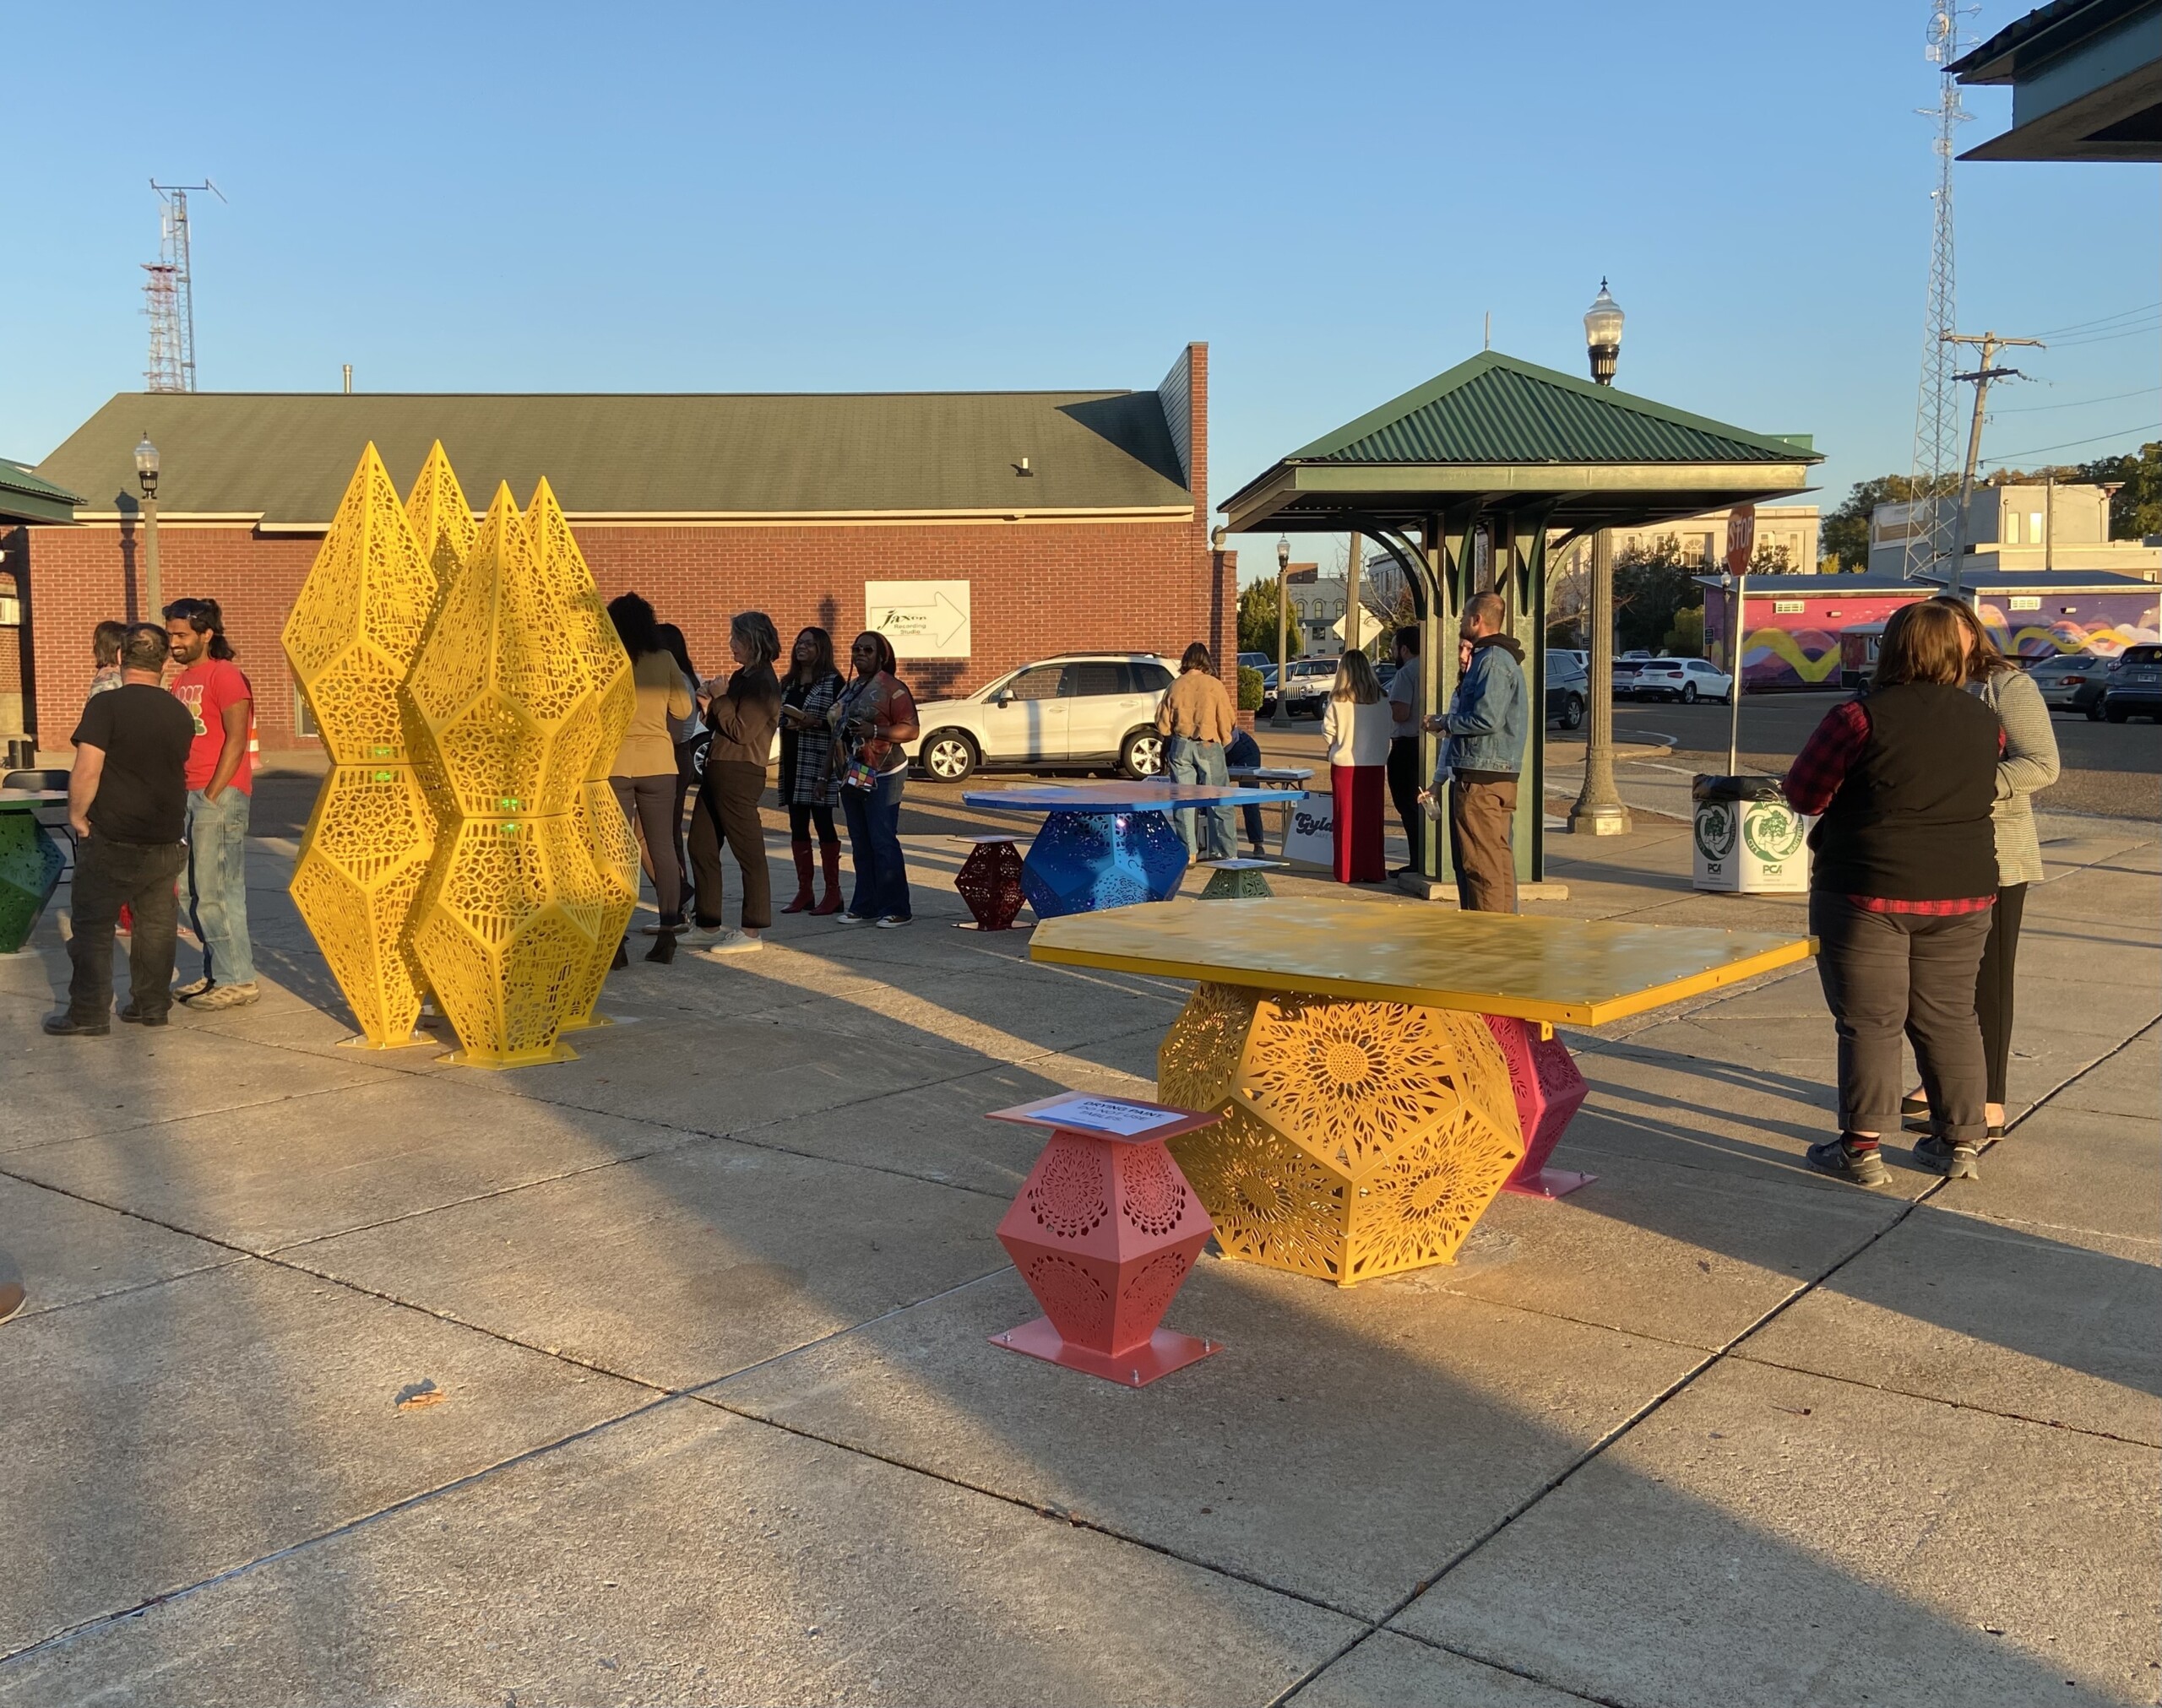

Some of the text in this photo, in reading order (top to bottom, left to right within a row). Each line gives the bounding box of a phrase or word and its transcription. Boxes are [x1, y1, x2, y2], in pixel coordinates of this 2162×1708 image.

[1728, 515, 1753, 552] STOP
[1747, 838, 1761, 854] CITY
[1708, 863, 1722, 873] PCA
[1763, 865, 1783, 874] PCA
[1083, 1101, 1128, 1111] DRYING
[1123, 1113, 1150, 1121] USE
